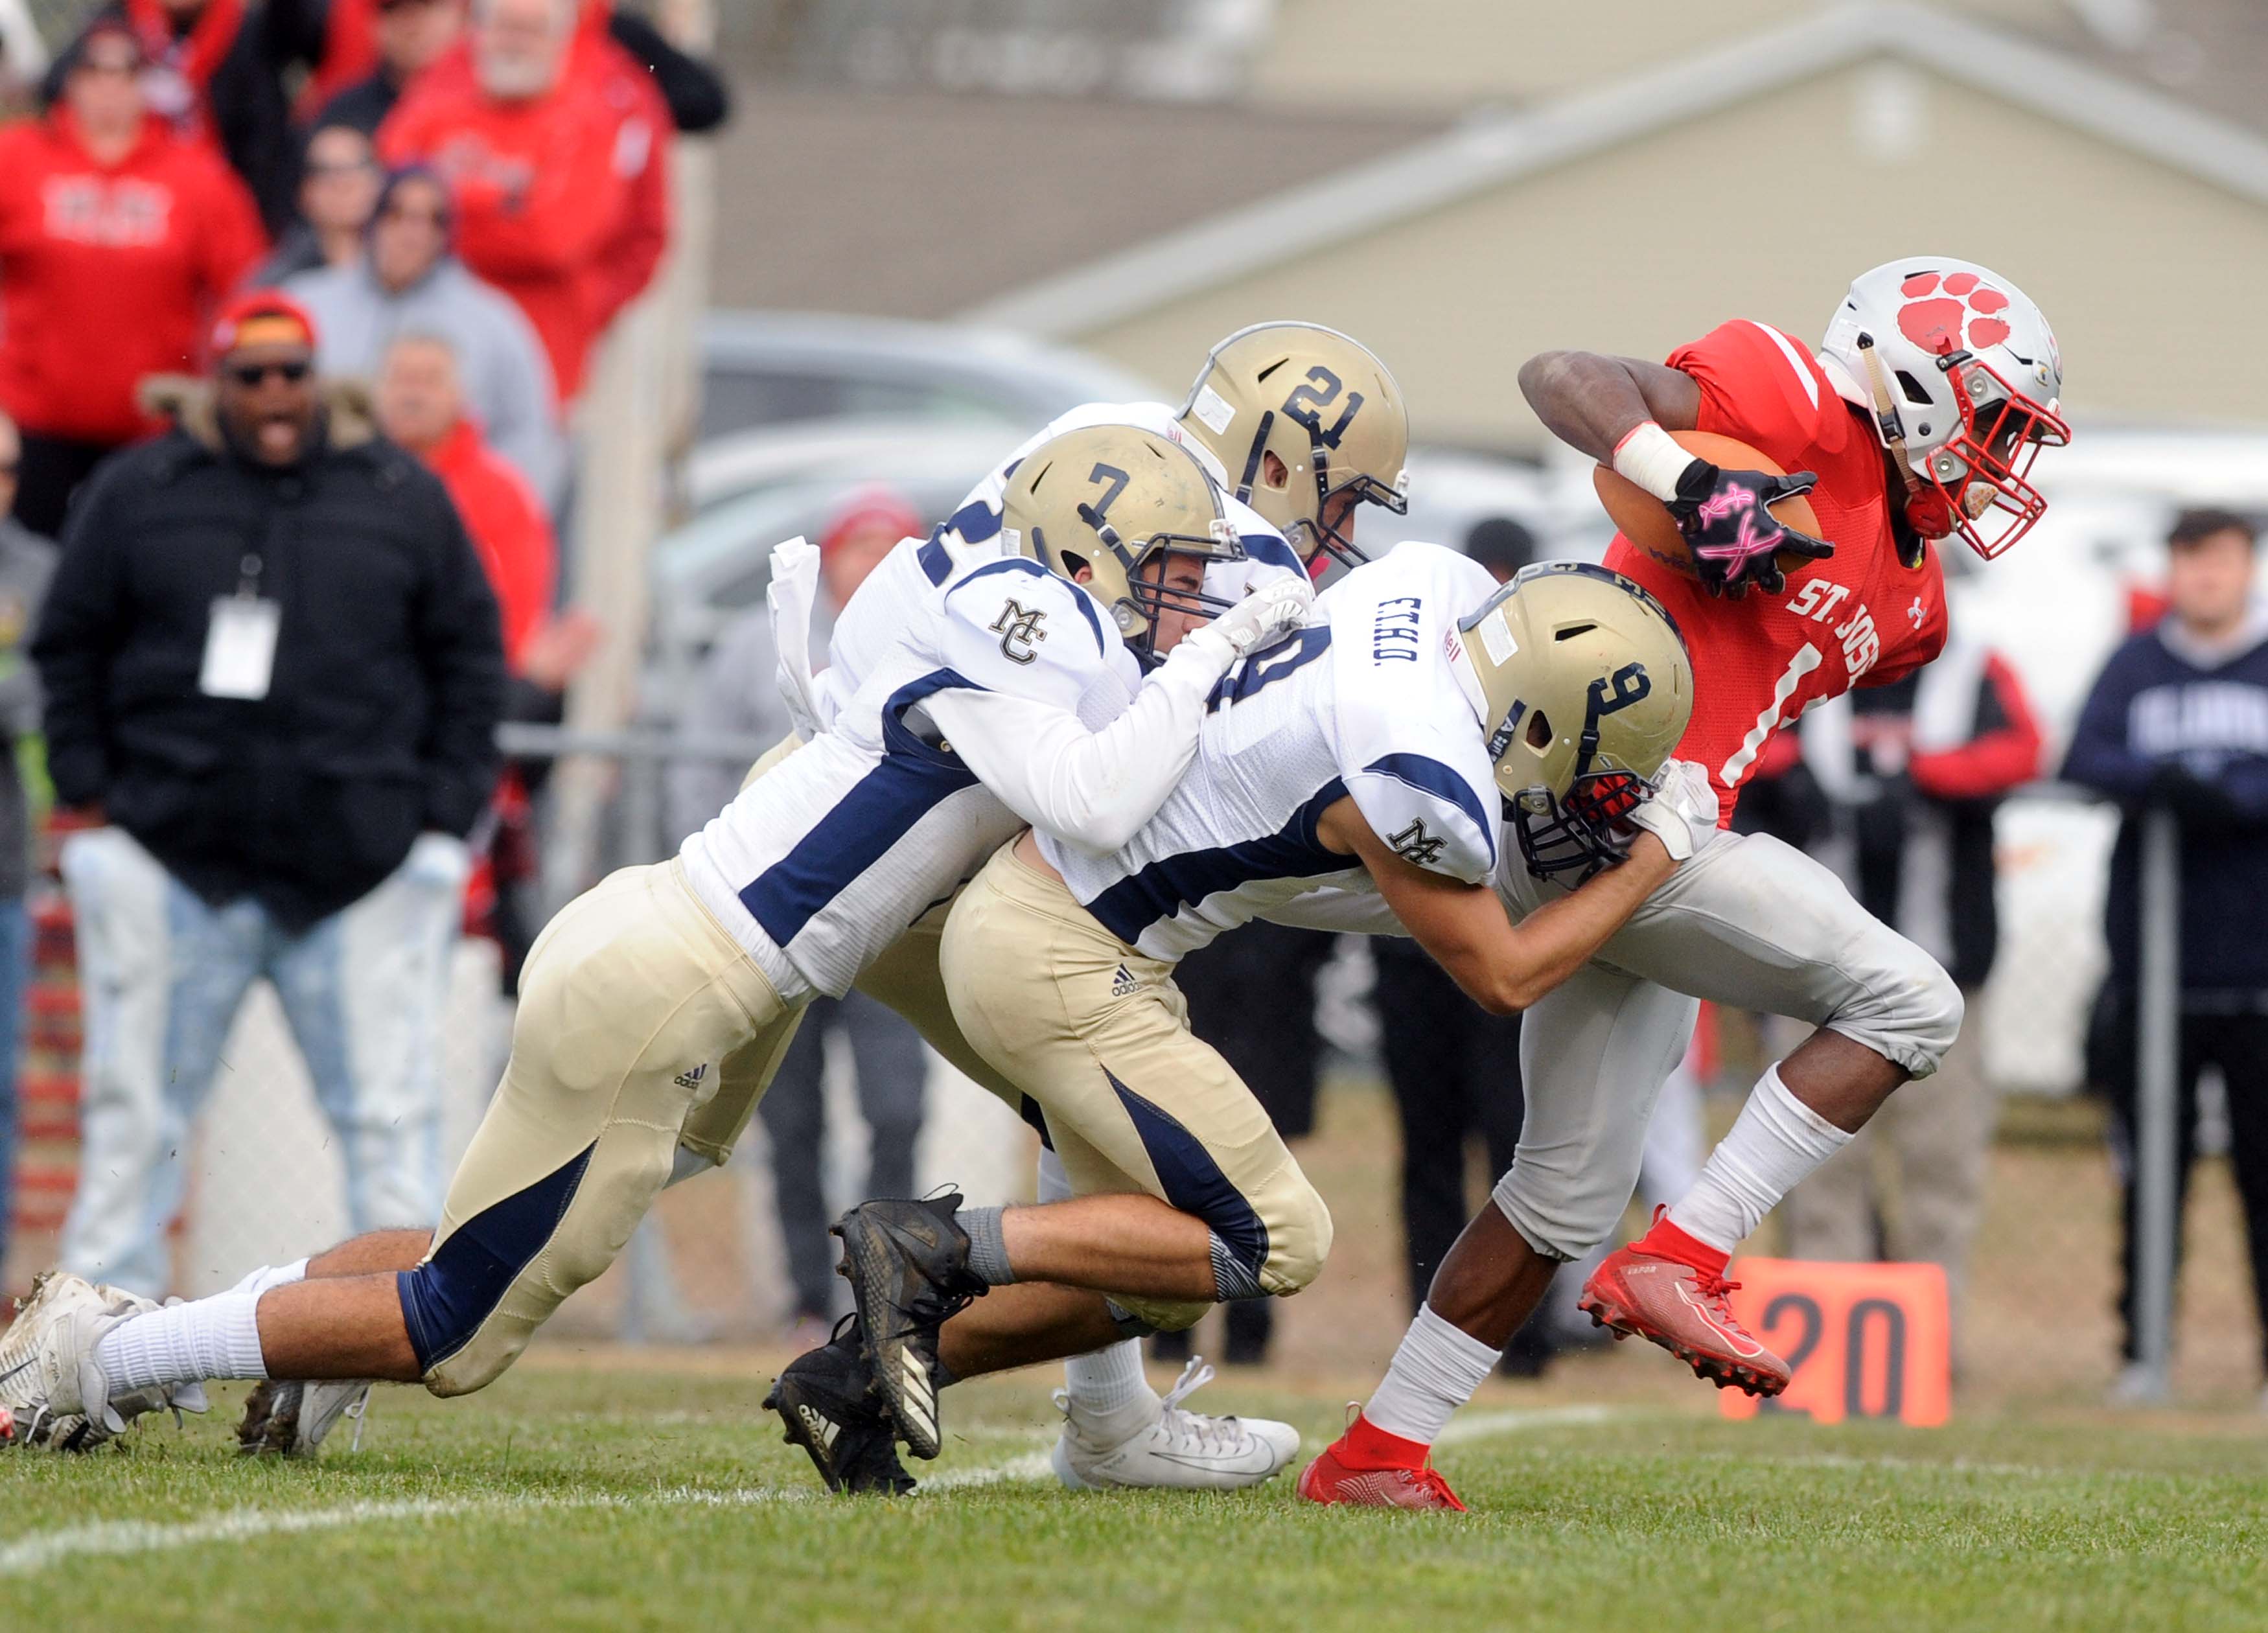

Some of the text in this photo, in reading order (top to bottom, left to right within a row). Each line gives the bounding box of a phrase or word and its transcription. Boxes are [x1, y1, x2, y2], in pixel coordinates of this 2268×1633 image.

[1281, 365, 1365, 450] 21
[1088, 461, 1130, 519] 7
[988, 597, 1047, 666] MC
[1785, 578, 1850, 625] ST.
[1761, 1292, 1905, 1418] 20
